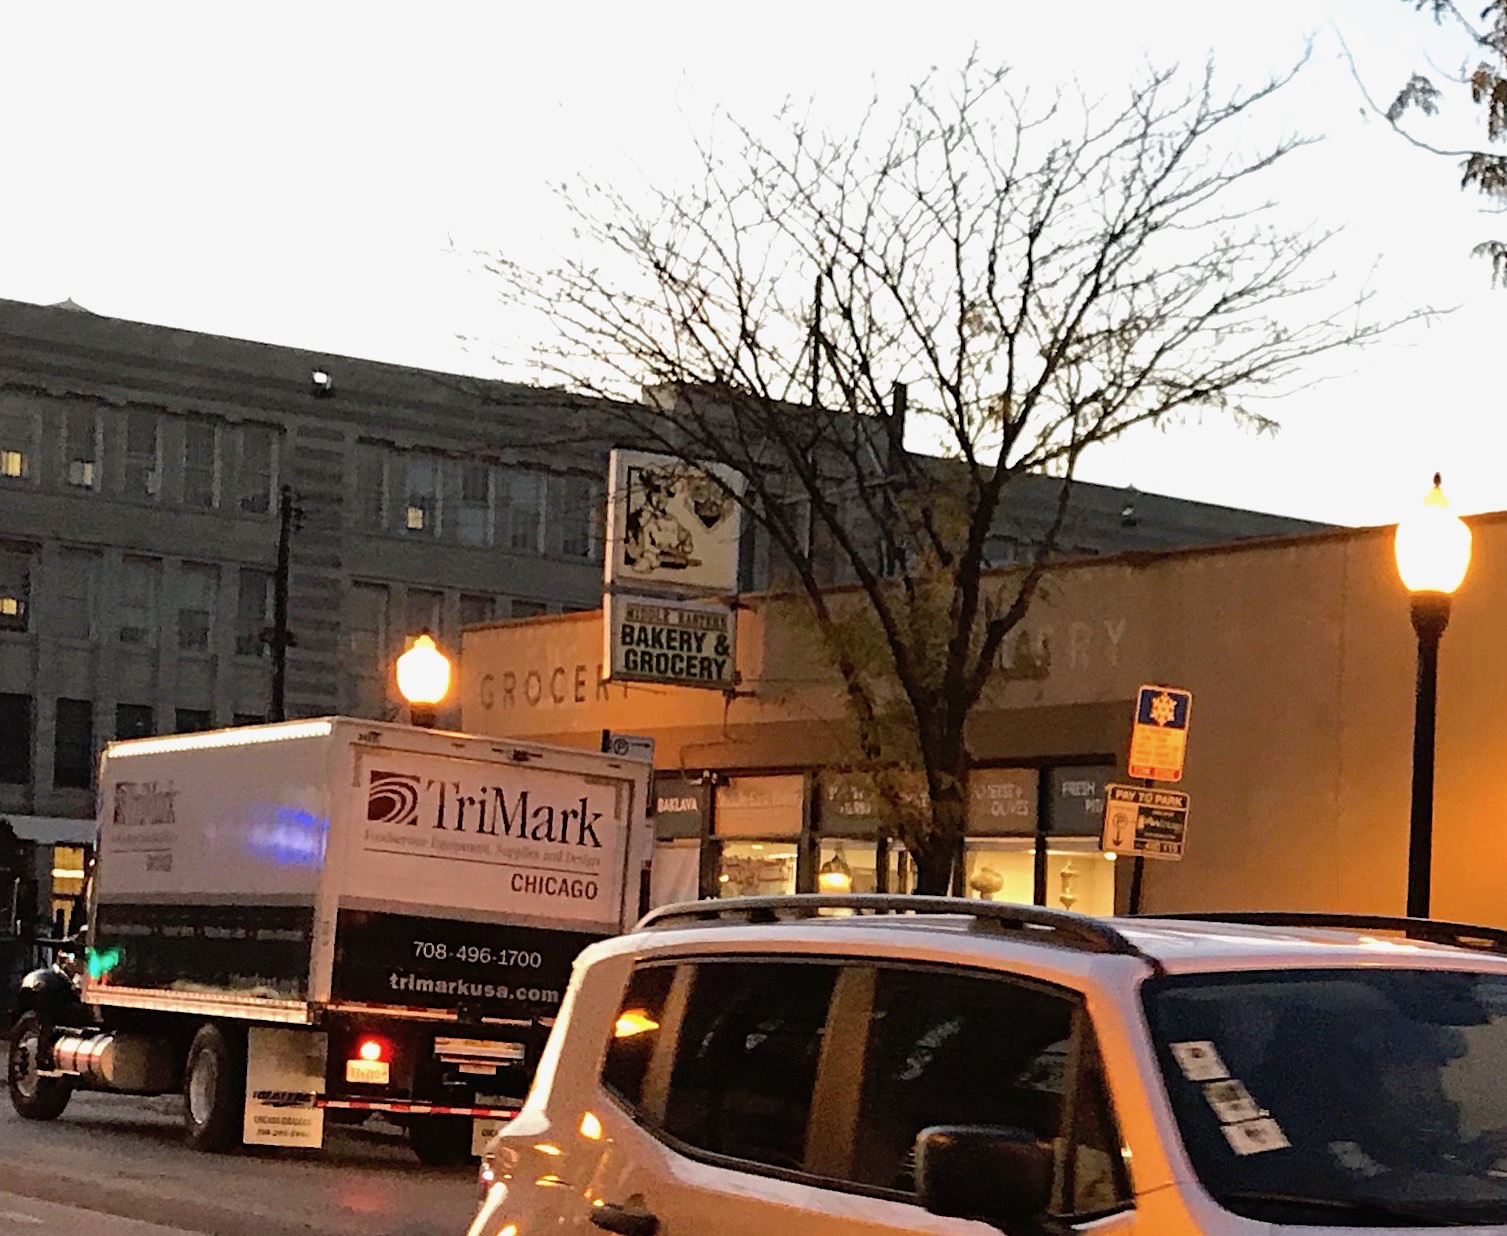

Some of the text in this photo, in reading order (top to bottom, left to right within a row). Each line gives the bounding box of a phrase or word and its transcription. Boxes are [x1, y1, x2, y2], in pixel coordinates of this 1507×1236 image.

[621, 624, 730, 657] BAKERY &
[624, 648, 726, 679] GROCERY
[657, 796, 698, 813] BAKLAVA
[1115, 789, 1183, 807] PAY TO PARK
[427, 779, 602, 848] TriMark
[511, 873, 598, 901] CHICAGO
[413, 941, 542, 968] 708-496-1700
[389, 973, 559, 1003] trimarkusa.com
